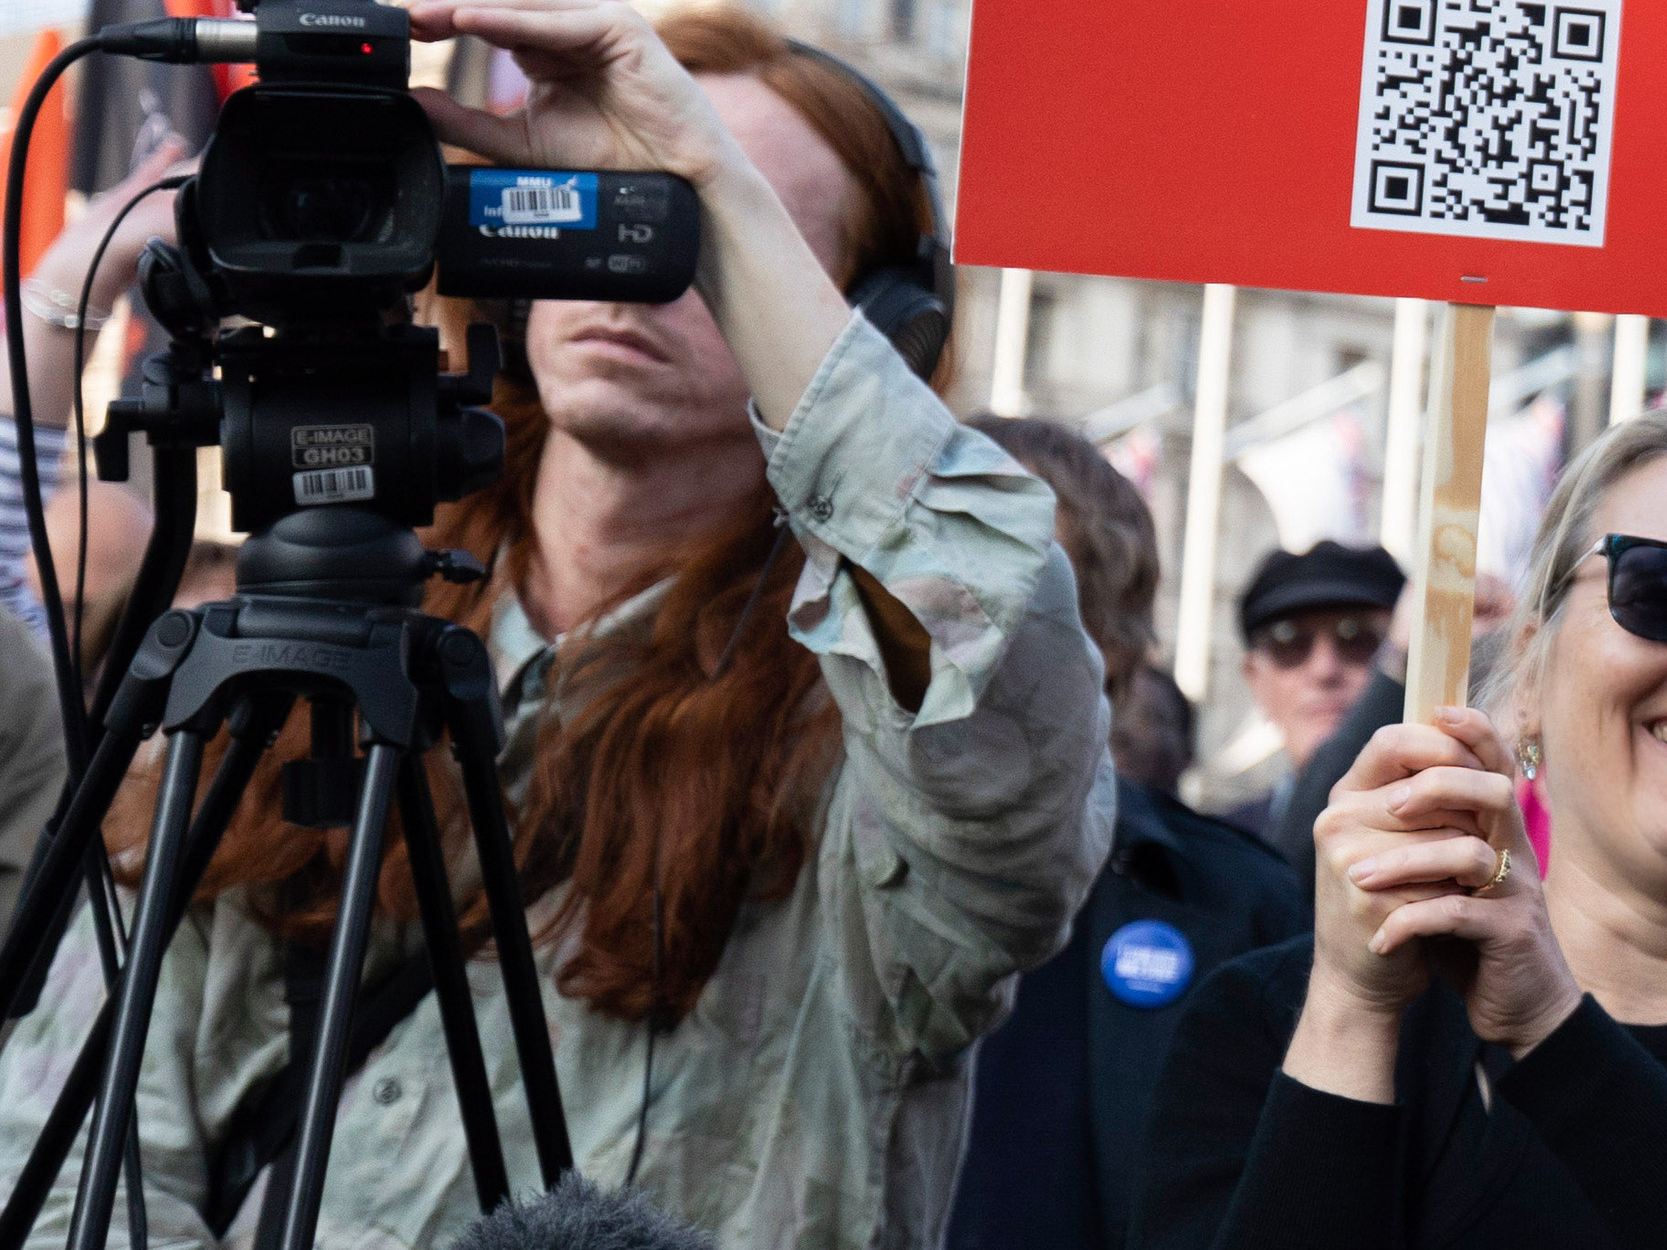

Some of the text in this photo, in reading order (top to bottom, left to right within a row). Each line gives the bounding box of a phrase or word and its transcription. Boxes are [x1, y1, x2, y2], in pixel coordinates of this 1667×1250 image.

[299, 12, 366, 28] Canon
[478, 224, 561, 240] Canon
[296, 429, 370, 445] E-IMAGE
[303, 448, 364, 464] GH03
